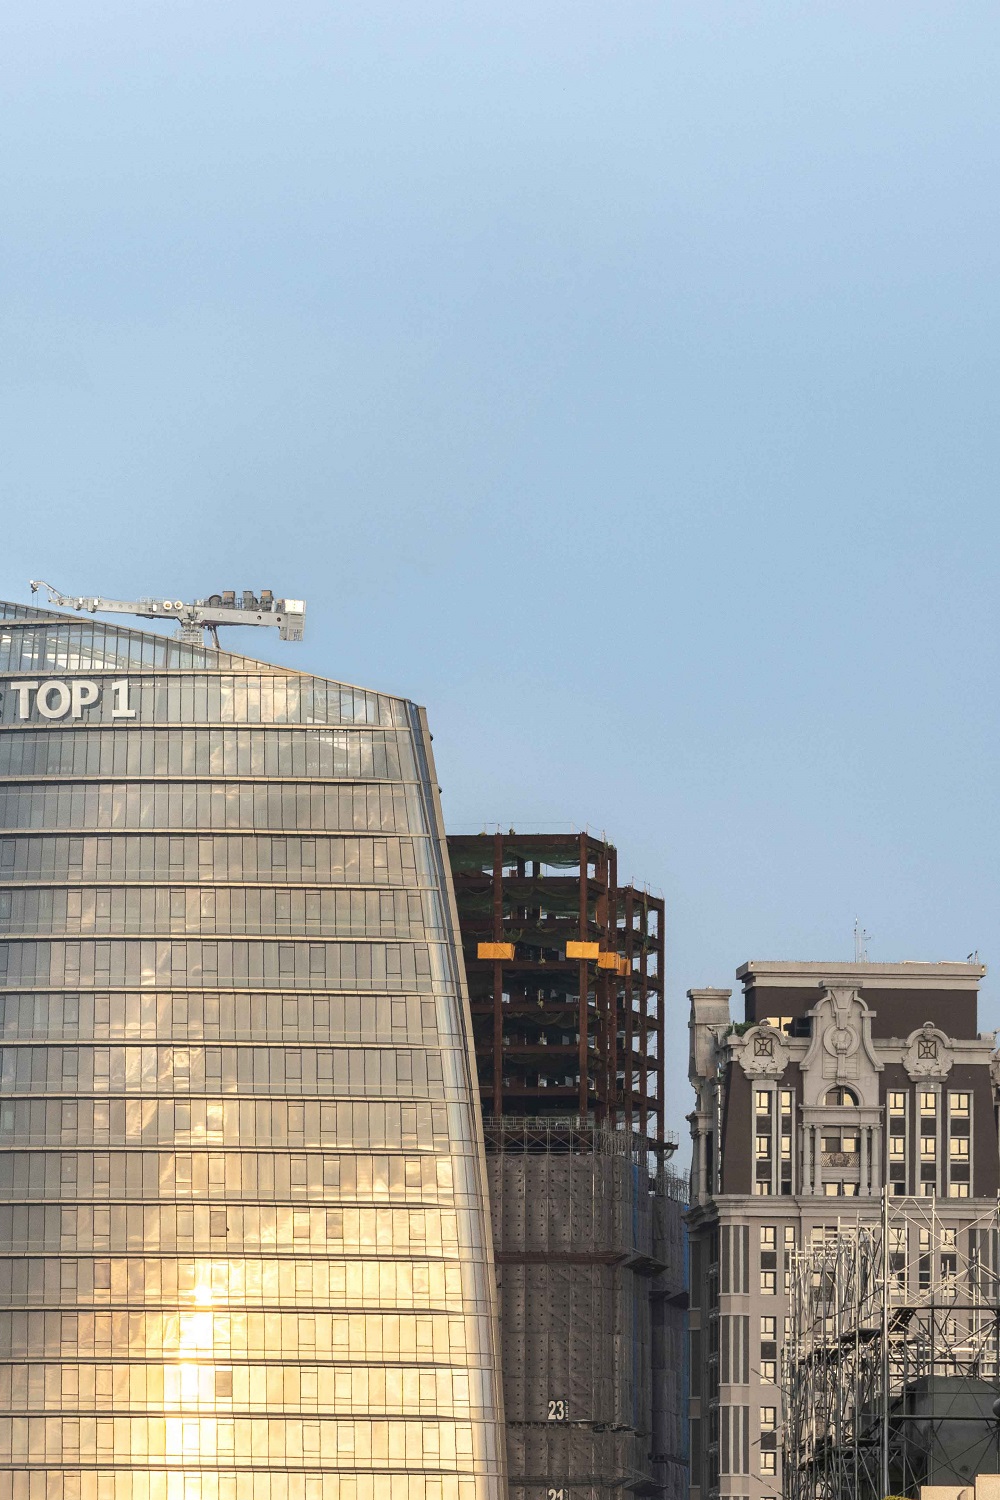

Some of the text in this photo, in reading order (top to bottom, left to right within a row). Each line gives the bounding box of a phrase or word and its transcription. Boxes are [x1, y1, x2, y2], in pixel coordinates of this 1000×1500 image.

[10, 679, 136, 719] TOP 1
[548, 1400, 565, 1421] 23
